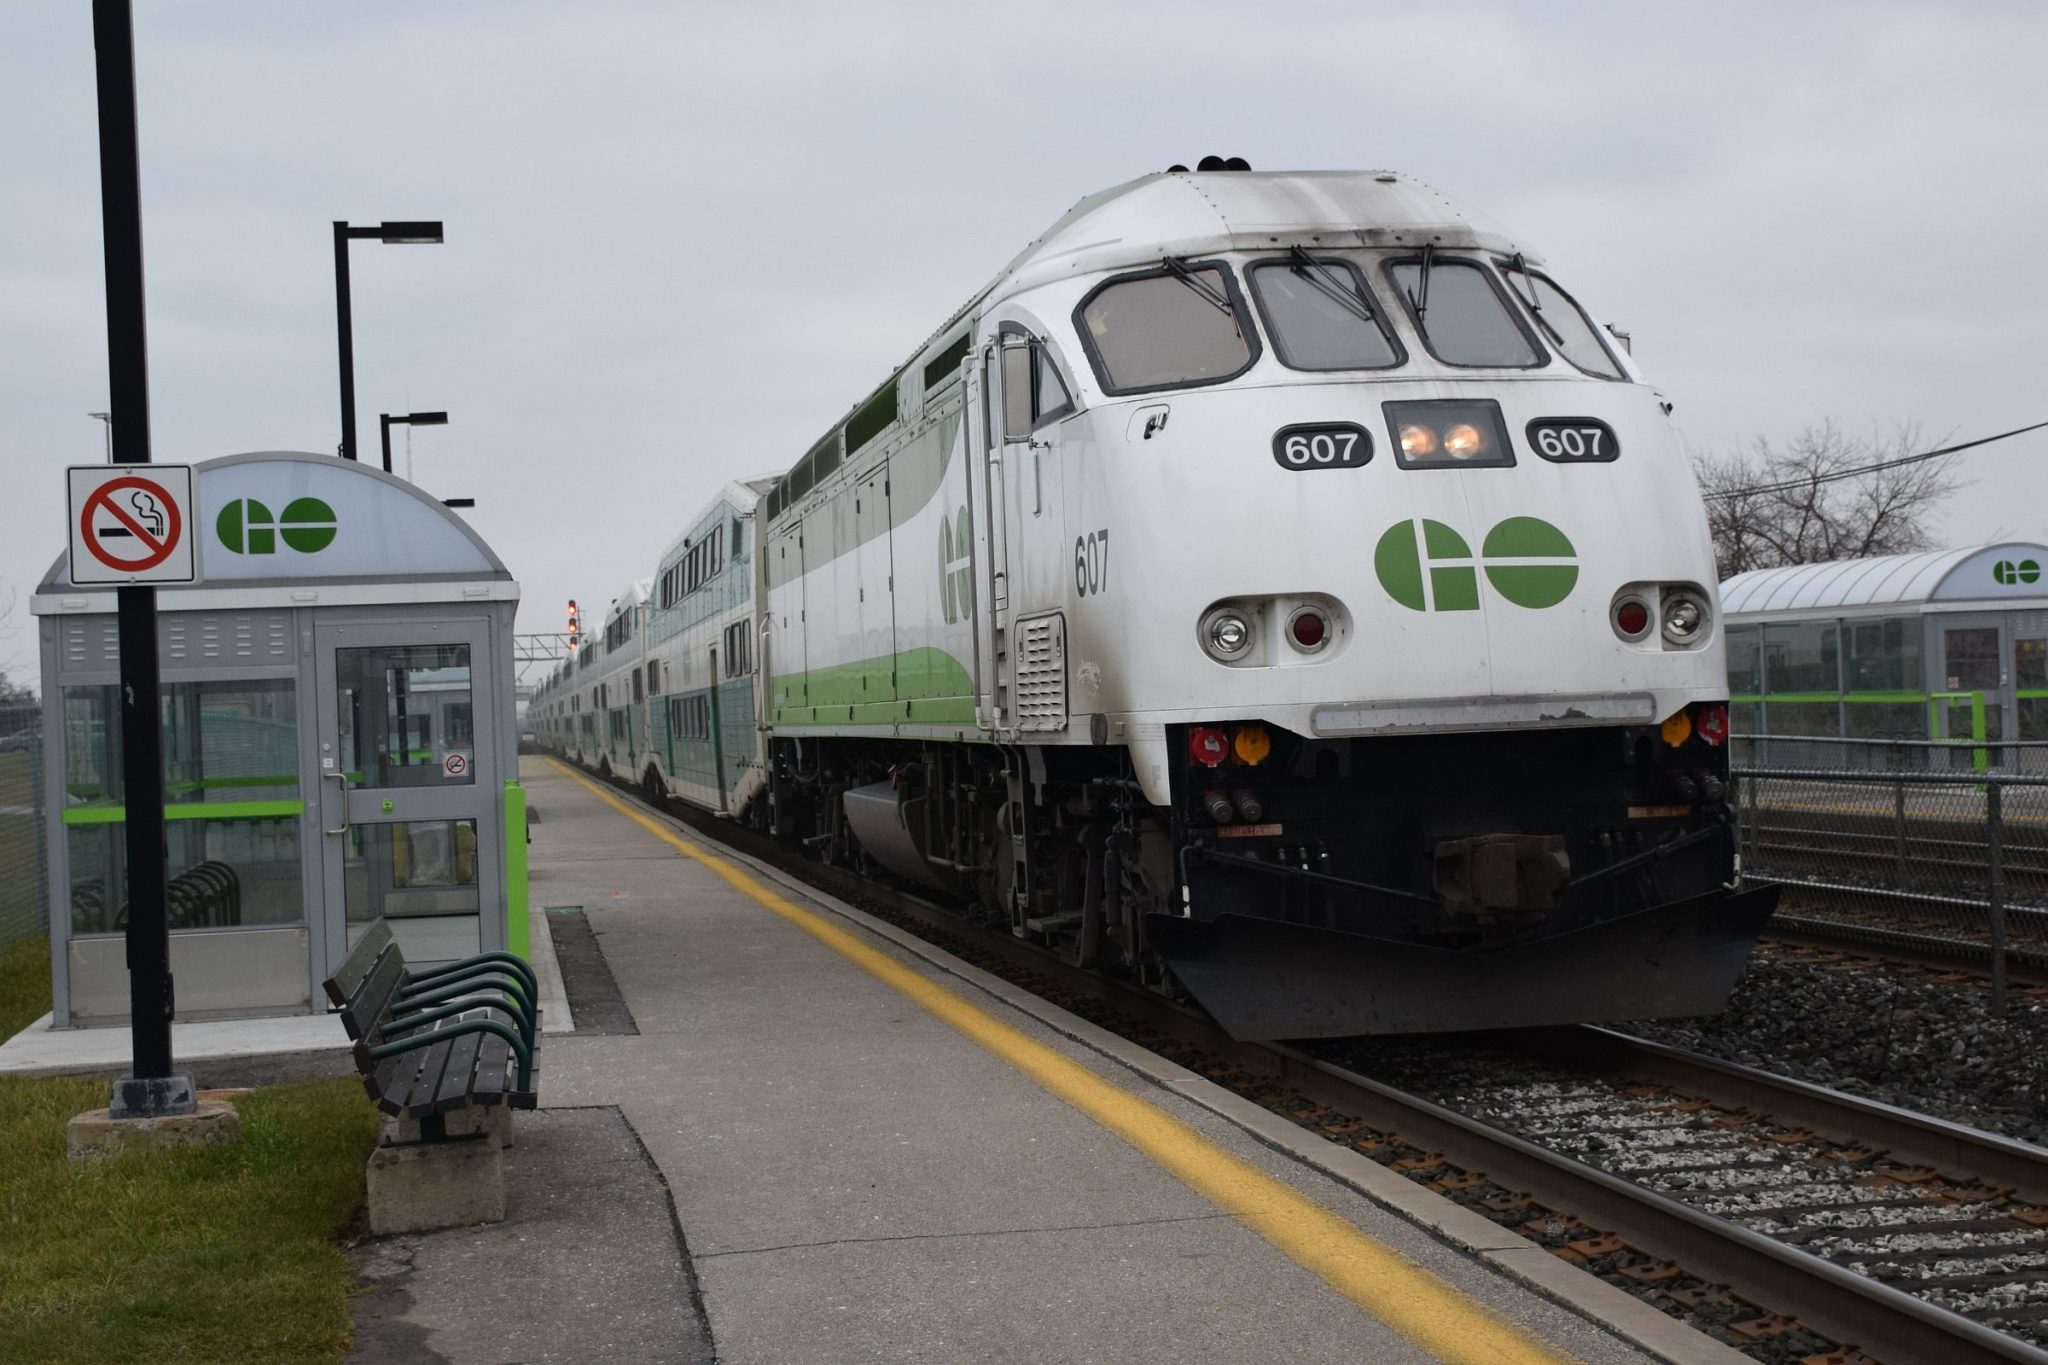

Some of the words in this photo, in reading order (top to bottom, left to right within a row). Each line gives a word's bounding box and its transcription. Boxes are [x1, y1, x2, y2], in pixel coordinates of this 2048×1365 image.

[1285, 433, 1359, 464] 607
[1538, 428, 1603, 457] 607
[1075, 528, 1108, 598] 607
[1374, 516, 1579, 612] GO
